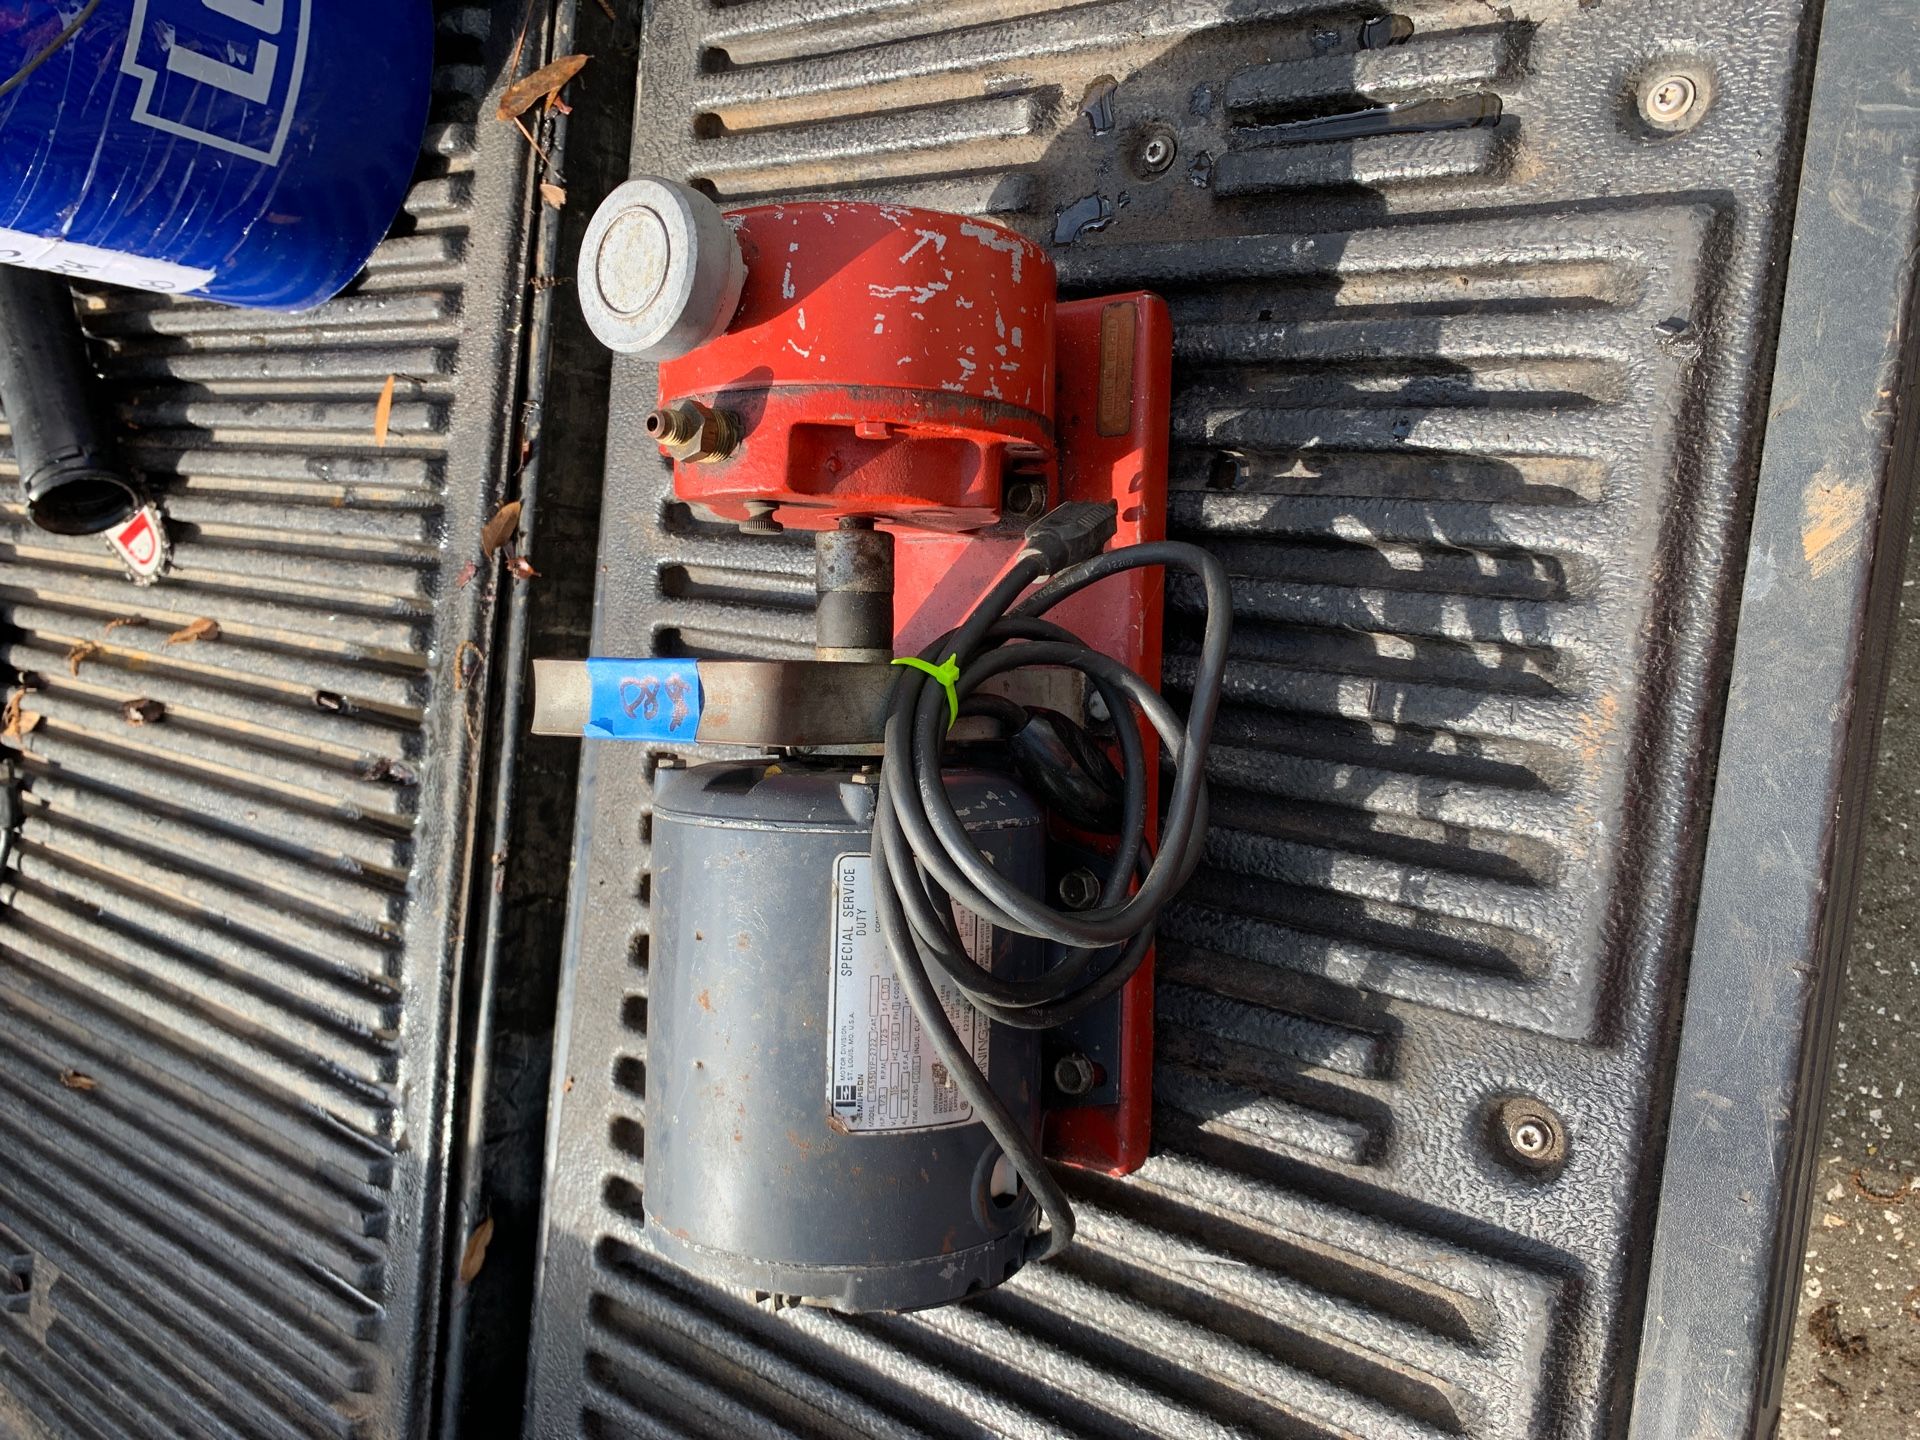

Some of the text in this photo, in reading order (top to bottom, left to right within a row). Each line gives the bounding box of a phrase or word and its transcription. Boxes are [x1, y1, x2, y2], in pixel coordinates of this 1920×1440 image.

[841, 868, 855, 977] SPECIAL SERVICE
[856, 908, 867, 936] DUTY
[880, 1029, 888, 1046] 1725
